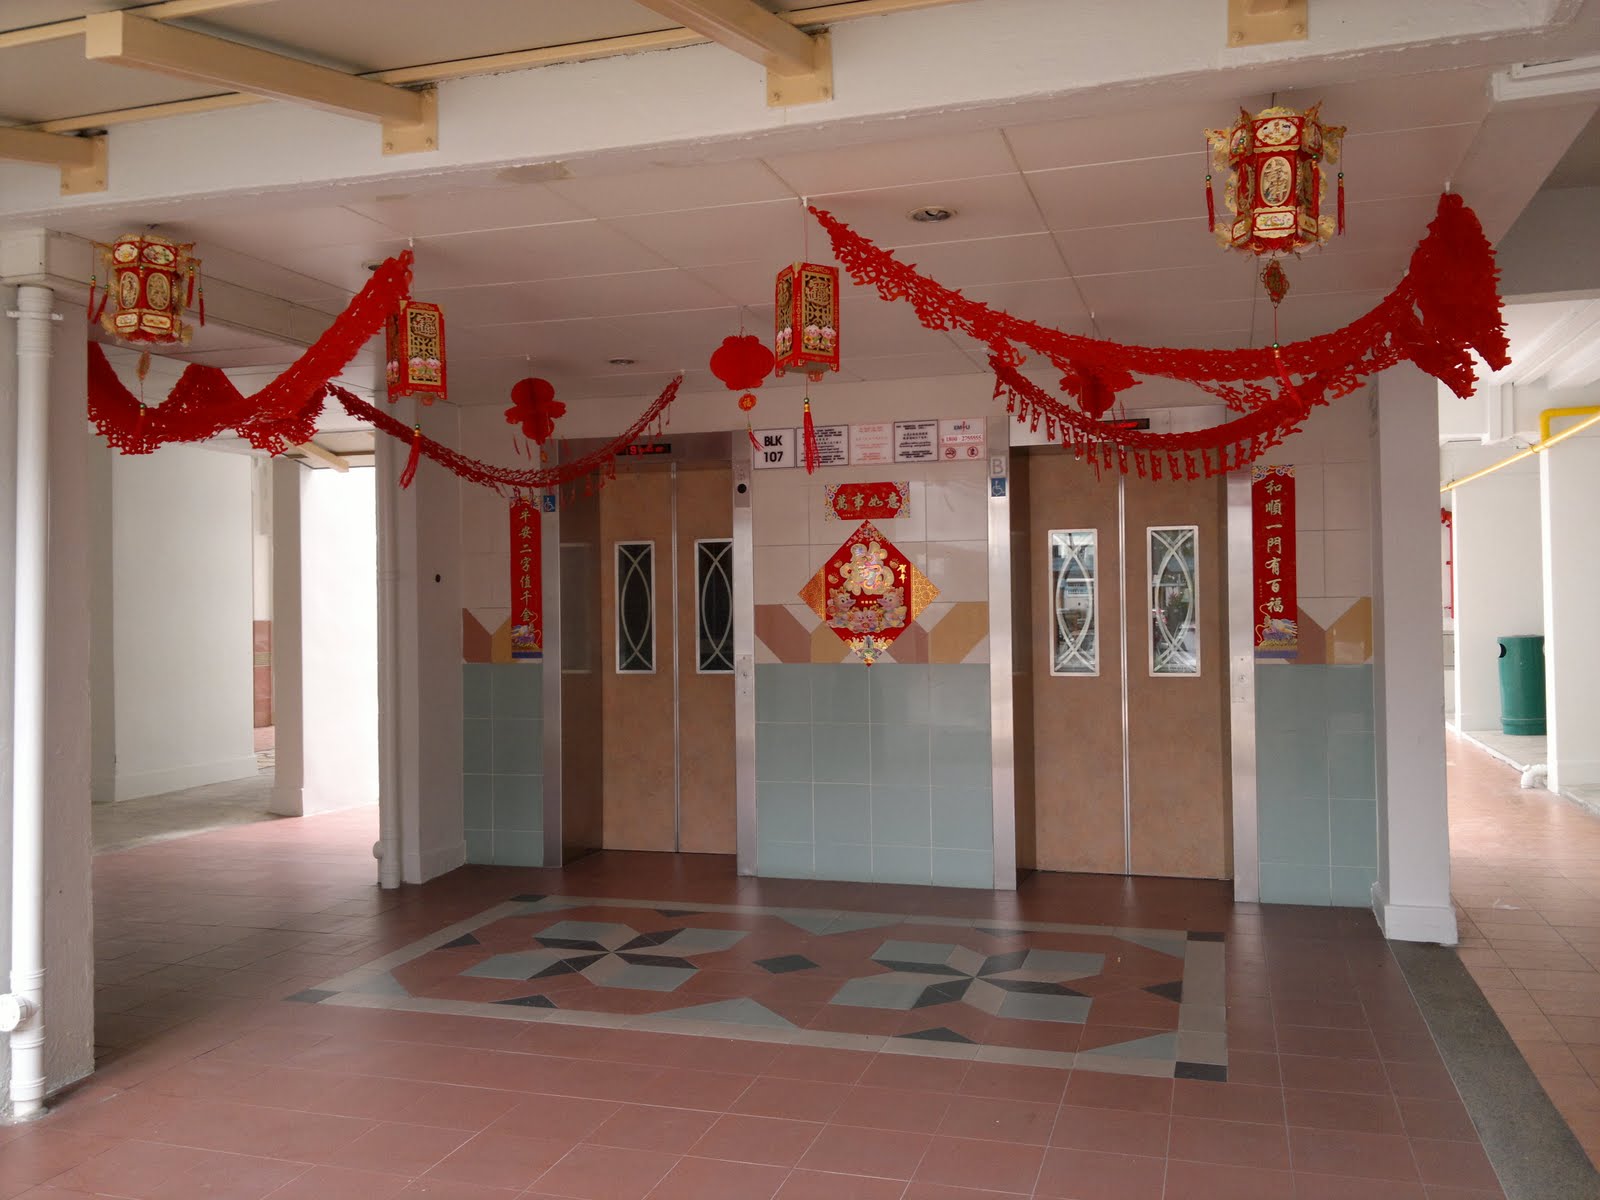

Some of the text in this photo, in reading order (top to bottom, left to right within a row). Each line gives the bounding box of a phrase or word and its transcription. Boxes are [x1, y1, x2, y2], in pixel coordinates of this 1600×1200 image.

[764, 435, 783, 447] BLK
[764, 451, 784, 463] 107
[992, 458, 1004, 474] B
[836, 492, 899, 511] 萬事如意
[1265, 480, 1284, 613] 和順一門有百福
[519, 508, 533, 621] 平安二字值千金
